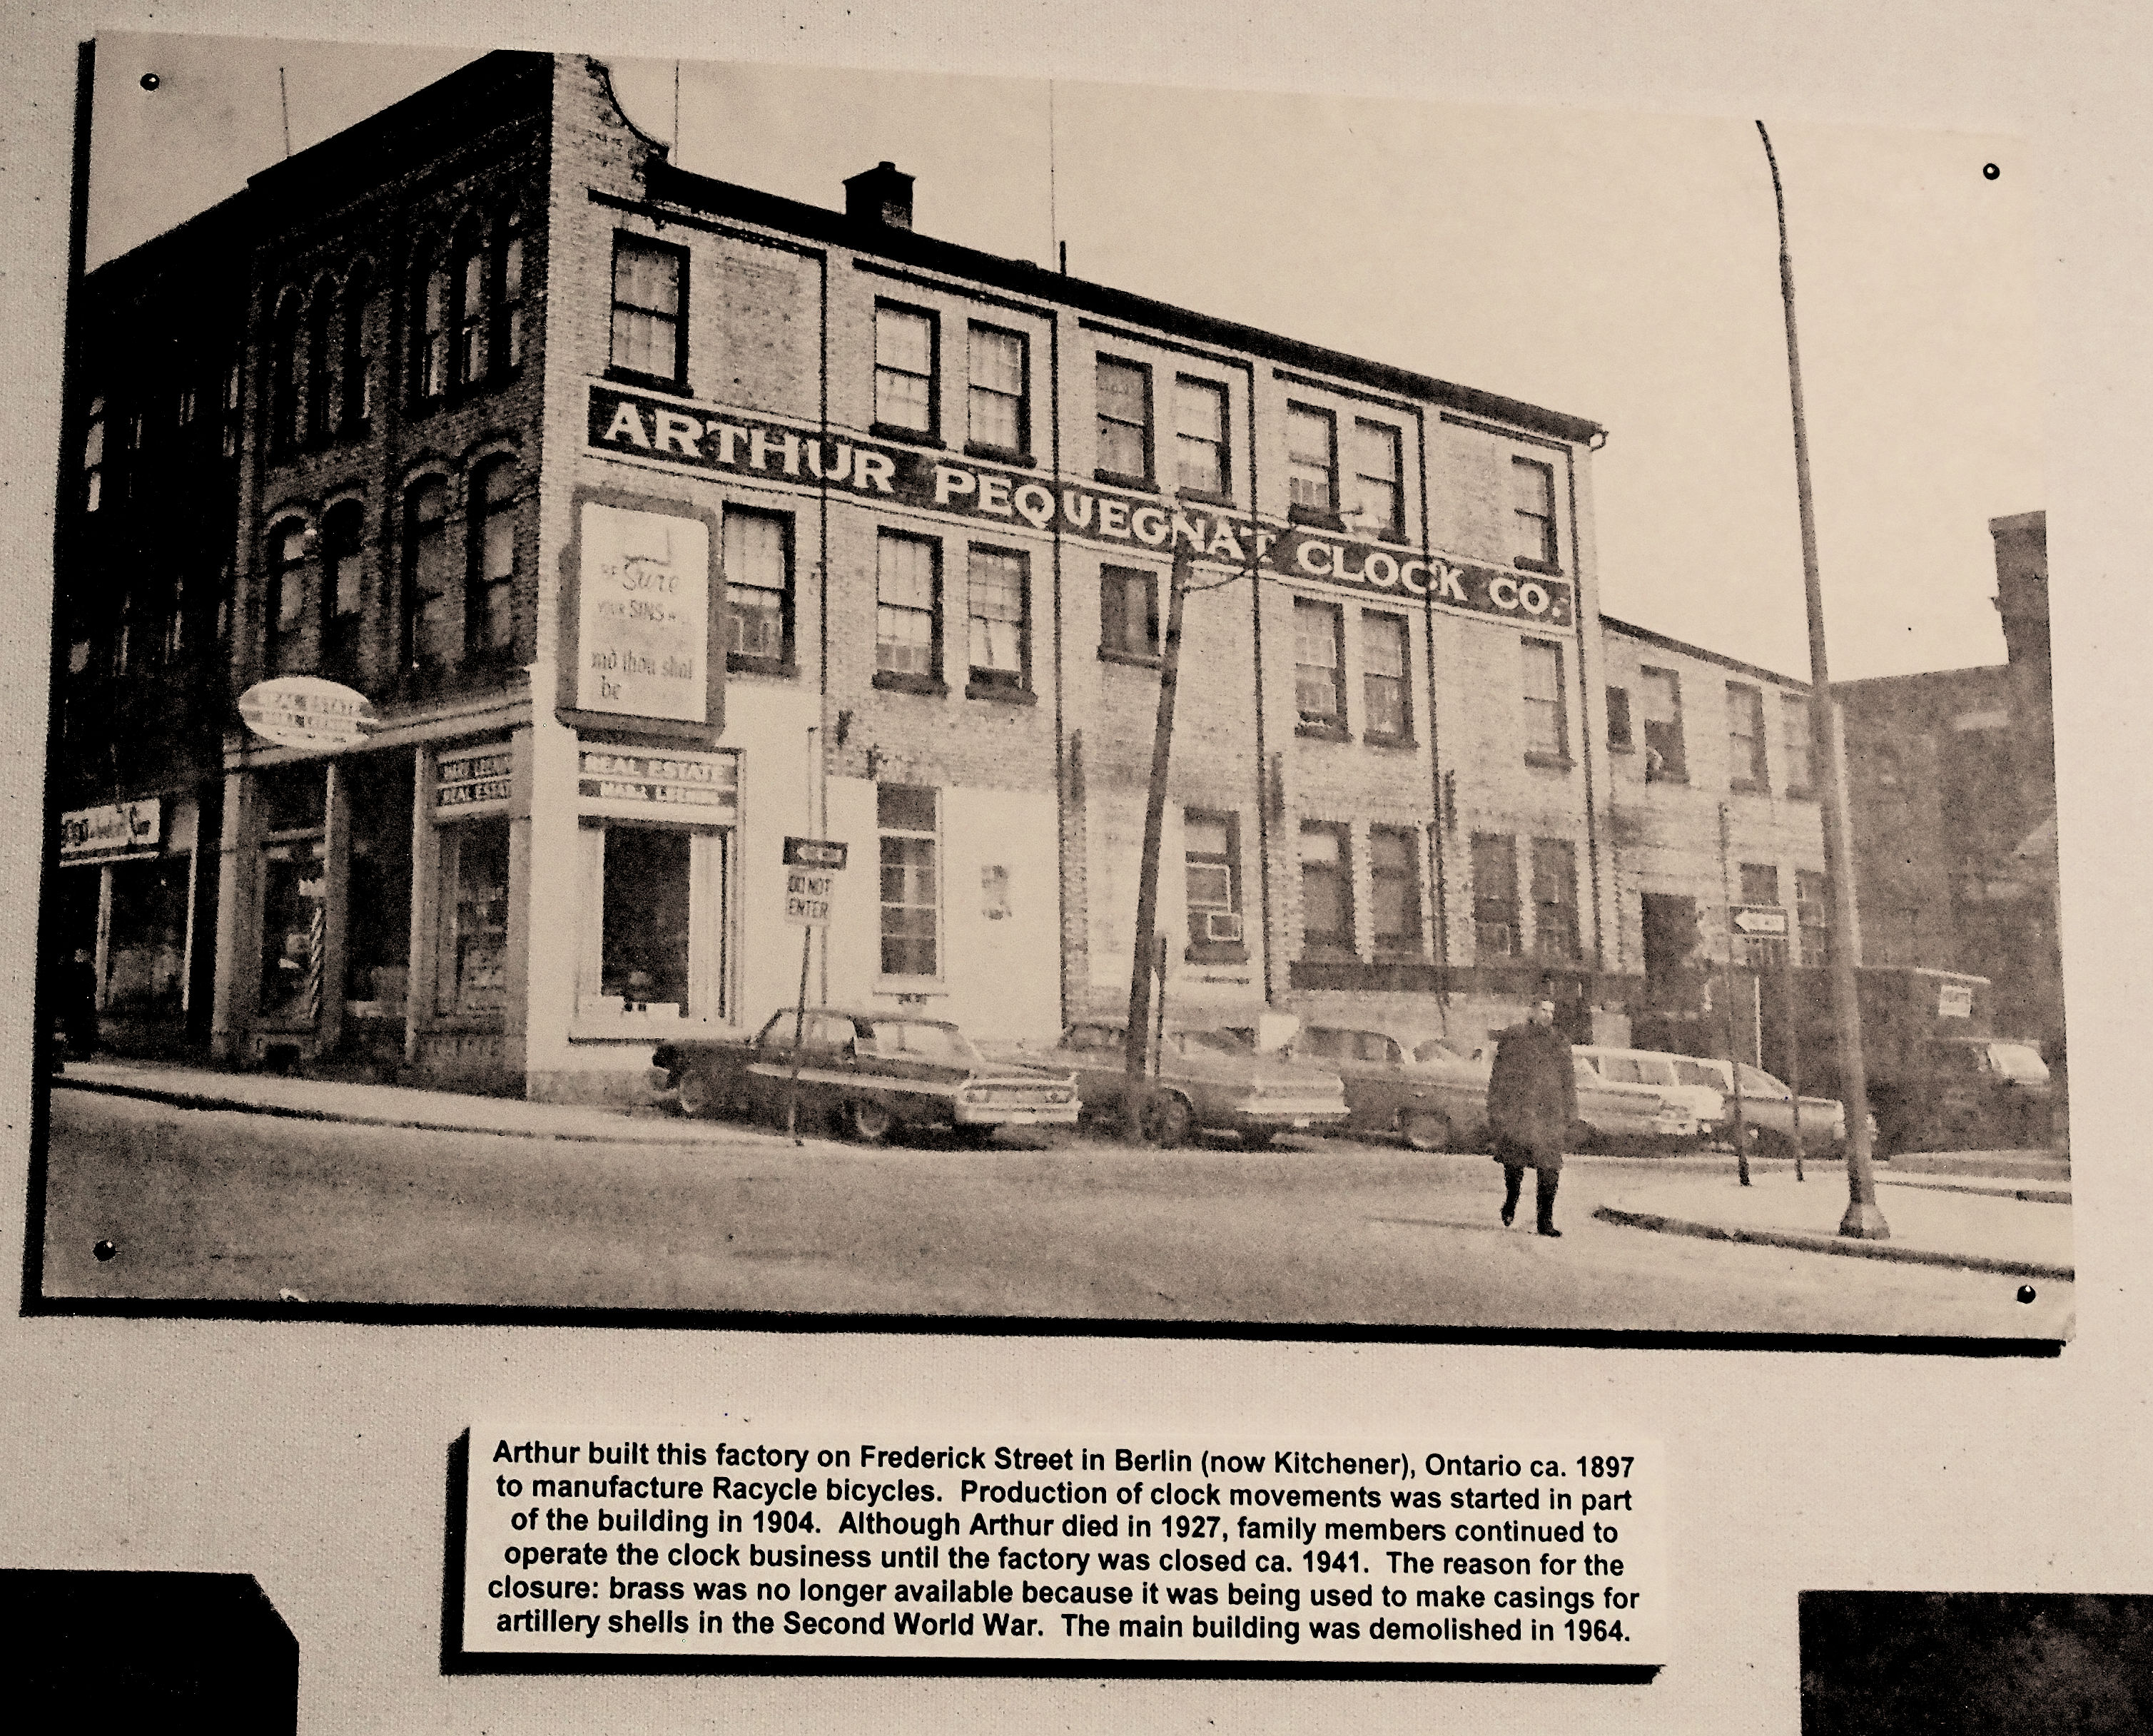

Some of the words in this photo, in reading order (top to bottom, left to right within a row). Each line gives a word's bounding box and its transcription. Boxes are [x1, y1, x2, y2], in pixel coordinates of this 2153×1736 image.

[604, 402, 896, 494] ARTHUR
[934, 465, 1277, 564] PEQUEGNAT
[1296, 539, 1469, 604] CLOCK
[1489, 577, 1562, 618] CO.
[808, 877, 832, 896] NOT
[788, 897, 829, 919] ENTER
[492, 1439, 581, 1464] Arthur
[589, 1441, 649, 1465] built
[657, 1442, 706, 1466] this
[715, 1442, 809, 1473] factory
[817, 1449, 850, 1468] on
[861, 1444, 986, 1469] Frederick
[994, 1446, 1073, 1471] Street
[1082, 1448, 1105, 1471] in
[1115, 1448, 1192, 1472] Berlin
[1201, 1450, 1266, 1478] (now
[1275, 1451, 1416, 1481] Kitchener),
[1425, 1453, 1521, 1477] Ontario
[1530, 1460, 1566, 1478] ca.
[1576, 1456, 1635, 1478] 1897
[496, 1474, 523, 1498] to
[532, 1474, 704, 1499] manufacture
[713, 1476, 818, 1506] Racycle
[826, 1478, 942, 1508] bicycles.
[961, 1479, 1107, 1504] Production
[1116, 1481, 1143, 1505] of
[1150, 1482, 1221, 1506] clock
[1230, 1486, 1382, 1508] movements
[1390, 1491, 1442, 1508] was
[1450, 1488, 1539, 1510] started
[1549, 1493, 1571, 1510] in
[1581, 1489, 1632, 1516] part
[510, 1507, 539, 1531] of
[545, 1507, 589, 1531] the
[598, 1508, 709, 1539] building
[719, 1509, 742, 1533] in
[753, 1510, 821, 1533] 1904.
[839, 1511, 960, 1541] Although
[969, 1512, 1055, 1536] Arthur
[1062, 1513, 1118, 1537] died
[1128, 1514, 1151, 1538] in
[1161, 1515, 1228, 1543] 1927,
[1237, 1516, 1317, 1545] family
[1325, 1518, 1447, 1541] members
[1455, 1519, 1584, 1543] continued
[1593, 1521, 1618, 1543] to
[504, 1542, 608, 1570] operate
[616, 1542, 659, 1566] the
[667, 1543, 740, 1567] clock
[750, 1543, 871, 1568] business
[881, 1545, 938, 1568] until
[948, 1545, 990, 1570] the
[998, 1546, 1090, 1576] factory
[1098, 1553, 1150, 1571] was
[1159, 1548, 1246, 1572] closed
[1255, 1554, 1292, 1573] ca.
[1302, 1550, 1369, 1573] 1941.
[1386, 1550, 1434, 1575] The
[1443, 1557, 1531, 1575] reason
[1539, 1553, 1577, 1575] for
[1584, 1553, 1624, 1577] the
[488, 1574, 599, 1599] closure:
[609, 1575, 684, 1600] brass
[693, 1582, 747, 1600] was
[757, 1583, 791, 1601] no
[800, 1578, 888, 1608] longer
[894, 1579, 1013, 1603] available
[1022, 1580, 1133, 1605] because
[1143, 1581, 1159, 1605] it
[1166, 1587, 1219, 1605] was
[1228, 1582, 1300, 1612] being
[1310, 1583, 1372, 1607] used
[1381, 1585, 1407, 1608] to
[1417, 1585, 1486, 1608] make
[1494, 1585, 1595, 1615] casings
[1603, 1586, 1640, 1610] for
[496, 1608, 601, 1639] artillery
[608, 1609, 689, 1634] shells
[699, 1610, 723, 1634] in
[731, 1610, 775, 1635] the
[783, 1610, 885, 1635] Second
[893, 1612, 974, 1636] World
[982, 1613, 1043, 1637] War.
[1060, 1613, 1110, 1638] The
[1119, 1614, 1182, 1638] main
[1192, 1615, 1300, 1645] building
[1309, 1621, 1360, 1640] was
[1369, 1617, 1521, 1641] demolished
[1531, 1623, 1554, 1641] in
[1564, 1618, 1630, 1642] 1964.
